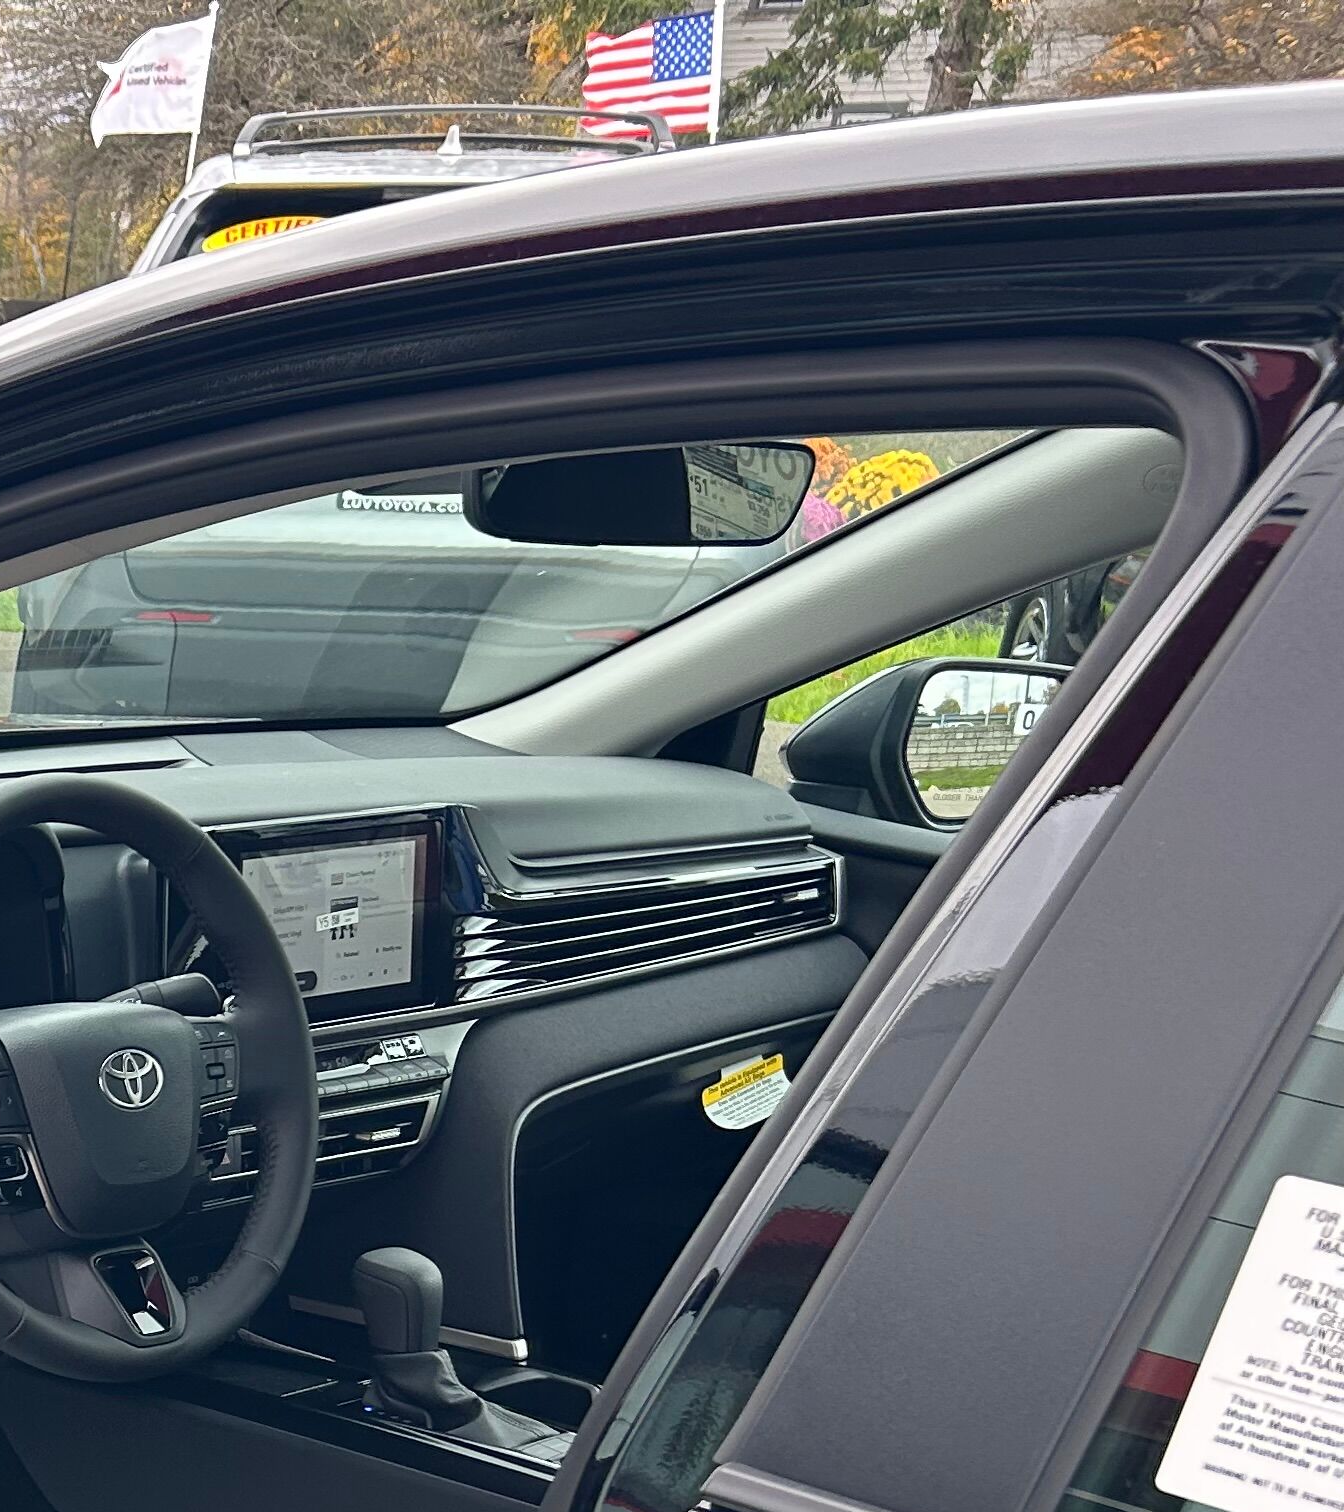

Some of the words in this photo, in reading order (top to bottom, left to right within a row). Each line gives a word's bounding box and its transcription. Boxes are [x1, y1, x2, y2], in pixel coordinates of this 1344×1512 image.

[129, 62, 169, 74] Certified
[127, 76, 150, 86] Used
[153, 75, 187, 86] Vehicles
[225, 219, 313, 243] CERTIF
[1305, 1207, 1341, 1226] FOR
[1278, 1273, 1313, 1291] FOR
[1292, 1292, 1339, 1315] FINAL
[1305, 1339, 1344, 1359] ENG
[1301, 1352, 1344, 1375] TRAN
[1230, 1393, 1257, 1409] This
[1263, 1402, 1307, 1424] Toyota
